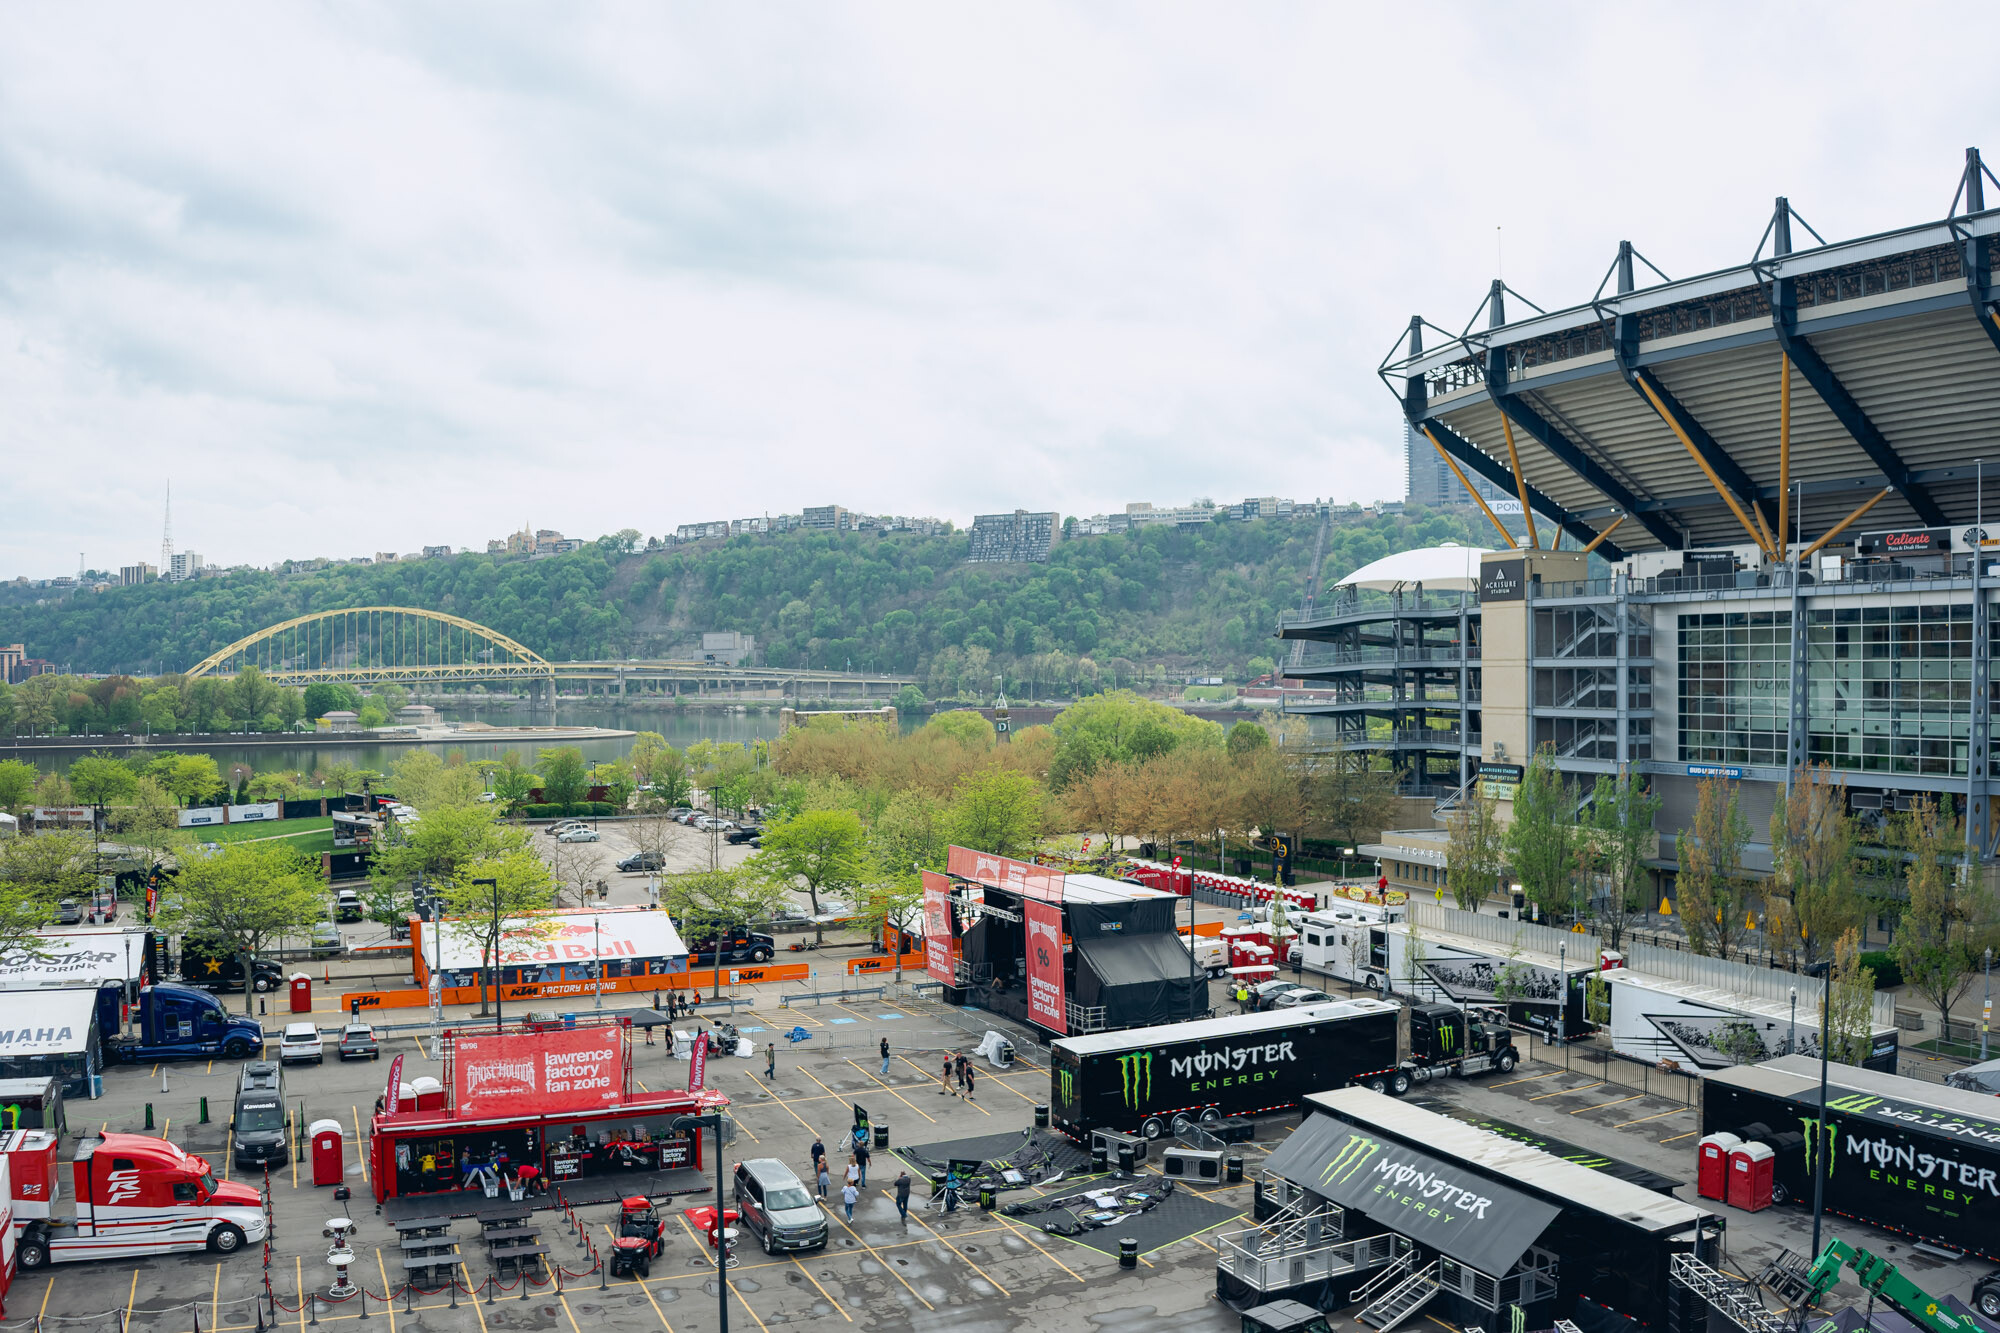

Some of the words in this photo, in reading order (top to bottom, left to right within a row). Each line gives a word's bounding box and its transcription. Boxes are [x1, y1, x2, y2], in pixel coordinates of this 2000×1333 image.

[1886, 533, 1930, 546] Caliente
[1485, 581, 1517, 589] ACRISURE
[1400, 846, 1442, 859] TICKET
[0, 951, 117, 966] CKSTAR
[562, 940, 637, 959] Bull
[45, 963, 97, 972] DRINK
[739, 970, 763, 980] KTM
[510, 986, 539, 997] KTM
[541, 983, 582, 995] FACTORY
[1030, 973, 1060, 996] lawrence
[1032, 986, 1055, 1007] factory
[1033, 998, 1043, 1012] fan
[1043, 1004, 1060, 1019] zone
[545, 1049, 614, 1066] lawrence
[692, 1041, 705, 1087] lawrence
[1170, 1041, 1297, 1079] MONSTER
[545, 1065, 599, 1080] factory
[1191, 1070, 1278, 1091] ENERGY
[388, 1065, 400, 1113] lawrence
[545, 1081, 571, 1094] fan
[574, 1076, 610, 1090] zone
[1846, 1134, 2000, 1198] MONSTER
[107, 1169, 141, 1204] CRF
[1373, 1158, 1493, 1220] MONSTER
[1870, 1169, 1974, 1205] ENERGY
[1373, 1184, 1455, 1224] ENERGY
